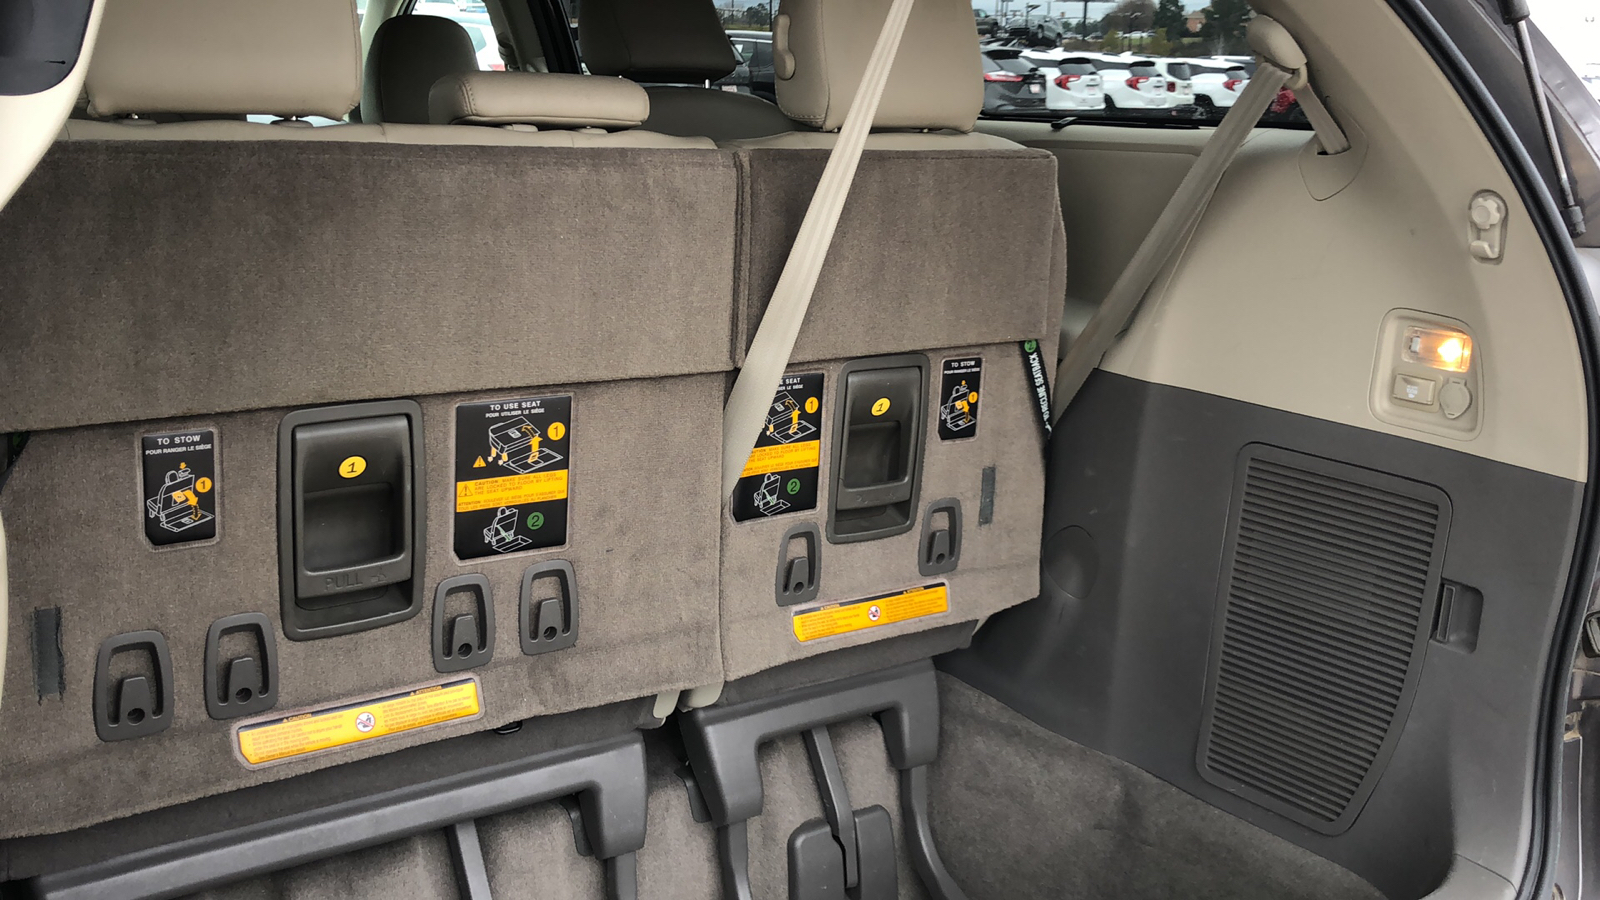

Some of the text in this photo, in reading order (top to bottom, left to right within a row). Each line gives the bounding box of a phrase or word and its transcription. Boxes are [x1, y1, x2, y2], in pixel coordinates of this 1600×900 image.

[1028, 352, 1044, 387] SEATBACK
[785, 377, 801, 385] SEAT
[503, 402, 519, 410] USE
[521, 400, 541, 409] SEAT
[156, 434, 201, 446] TO STOW
[145, 448, 162, 456] POUR
[162, 446, 187, 454] RANGER
[325, 573, 363, 591] PULL
